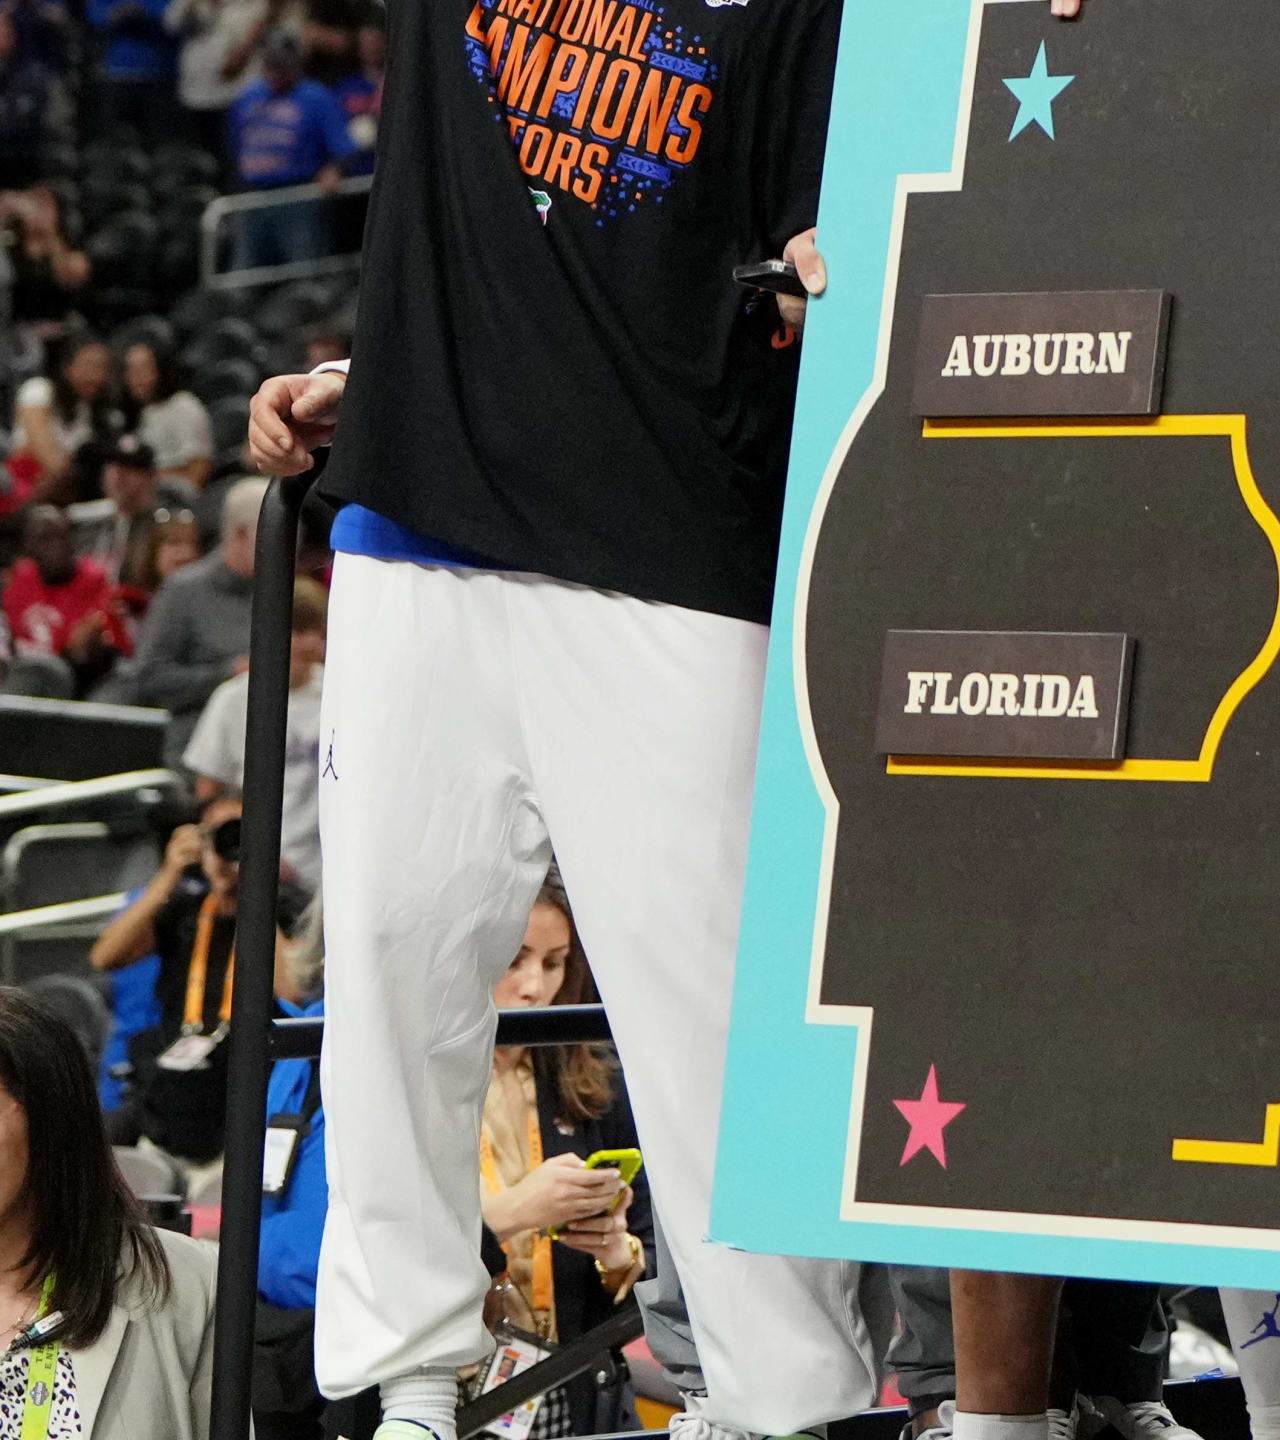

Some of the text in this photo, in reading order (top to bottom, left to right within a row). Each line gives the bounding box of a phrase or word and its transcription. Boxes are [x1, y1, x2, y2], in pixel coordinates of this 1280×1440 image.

[506, 115, 610, 203] TORS
[941, 331, 1132, 378] AUBURN
[904, 670, 1099, 719] FLORIDA
